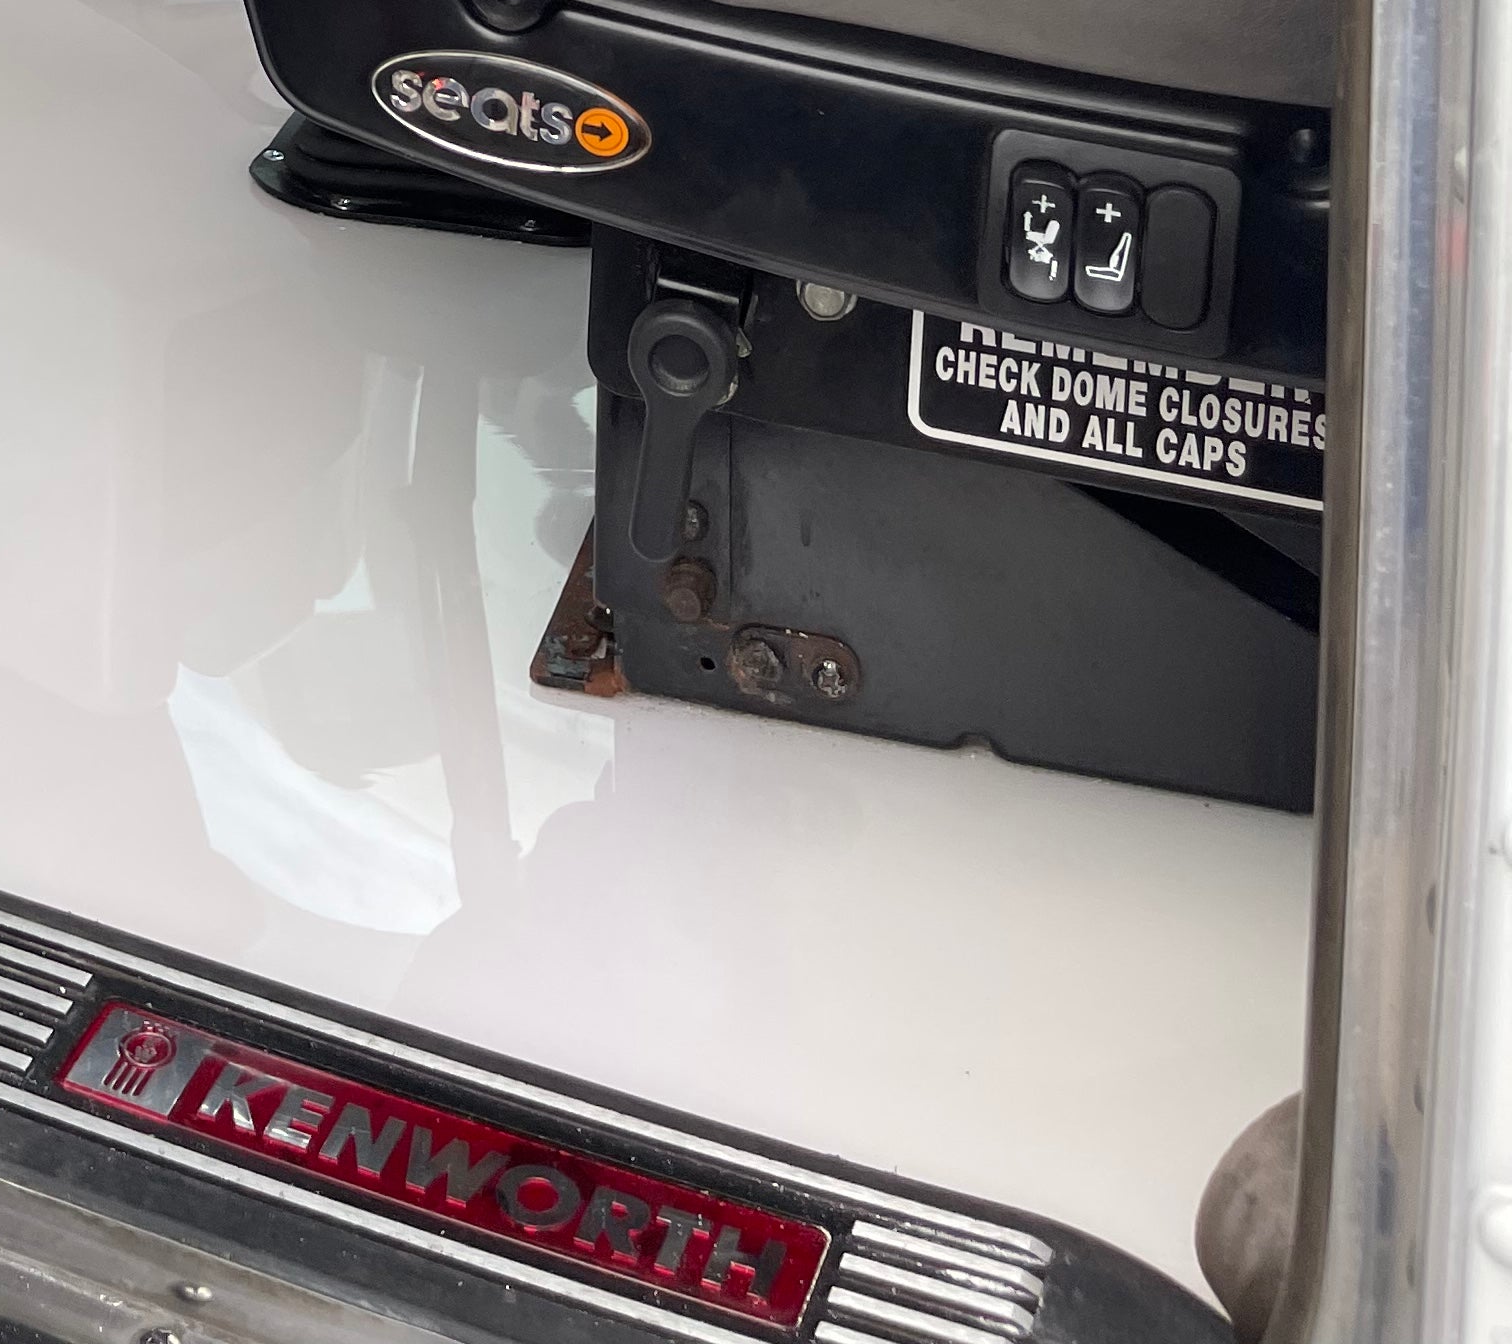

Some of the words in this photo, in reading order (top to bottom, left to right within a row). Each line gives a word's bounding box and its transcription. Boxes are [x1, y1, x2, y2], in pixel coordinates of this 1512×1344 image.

[390, 69, 573, 145] seats
[935, 345, 1041, 399] CHECK
[1051, 365, 1148, 417] DOME
[1159, 386, 1326, 451] CLOSURES
[1000, 399, 1070, 444] AND
[1081, 415, 1144, 459] ALL
[1155, 427, 1247, 478] CAPS
[198, 1064, 786, 1302] KENWORTH
